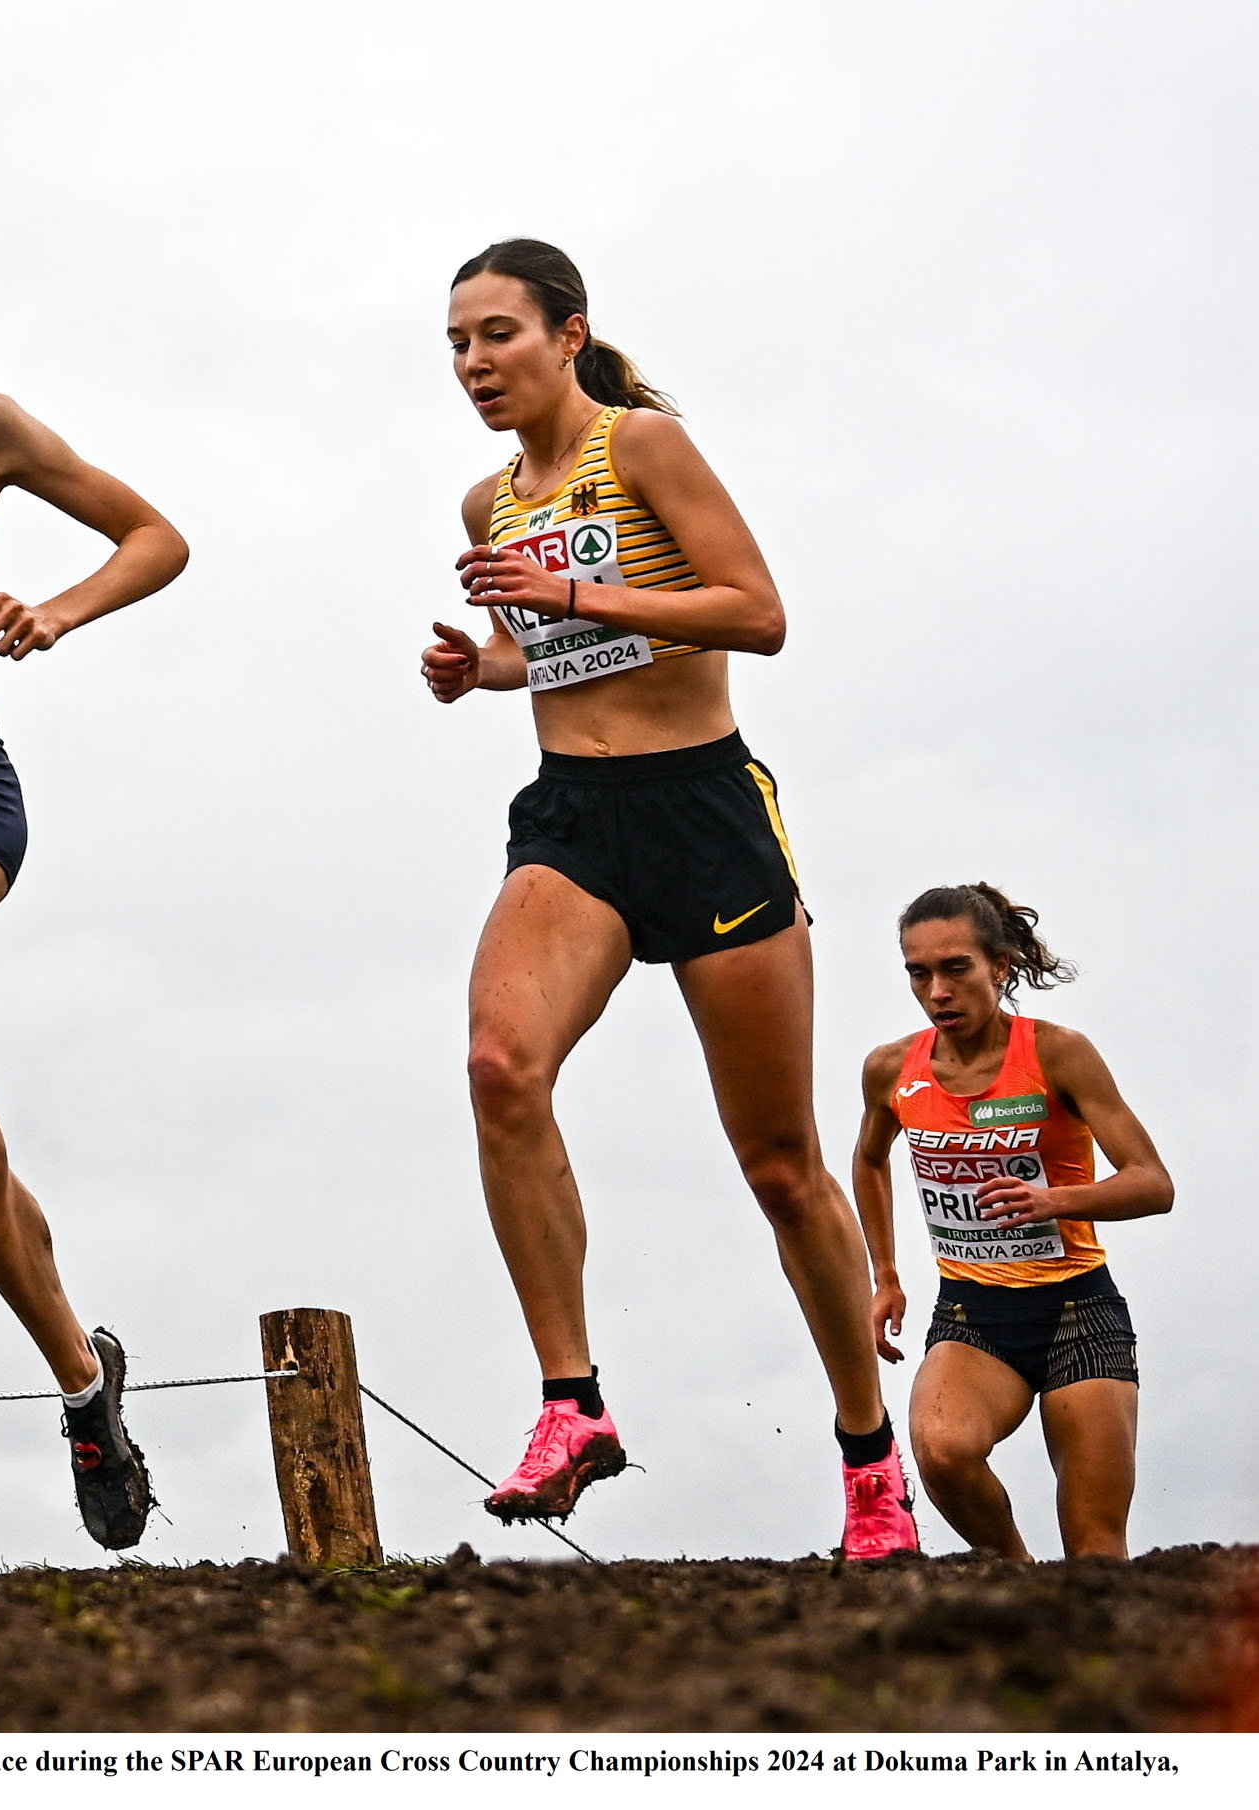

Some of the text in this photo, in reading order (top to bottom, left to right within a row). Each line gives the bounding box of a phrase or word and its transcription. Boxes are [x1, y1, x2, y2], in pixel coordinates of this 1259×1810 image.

[522, 536, 566, 569] AR
[582, 642, 640, 673] 2024
[994, 1103, 1044, 1118] Iberdrola
[906, 1126, 1041, 1150] ESPAÑA
[915, 1157, 1004, 1180] SPAR
[952, 1230, 978, 1241] RUN
[938, 1240, 1055, 1259] ANTALYA 2024
